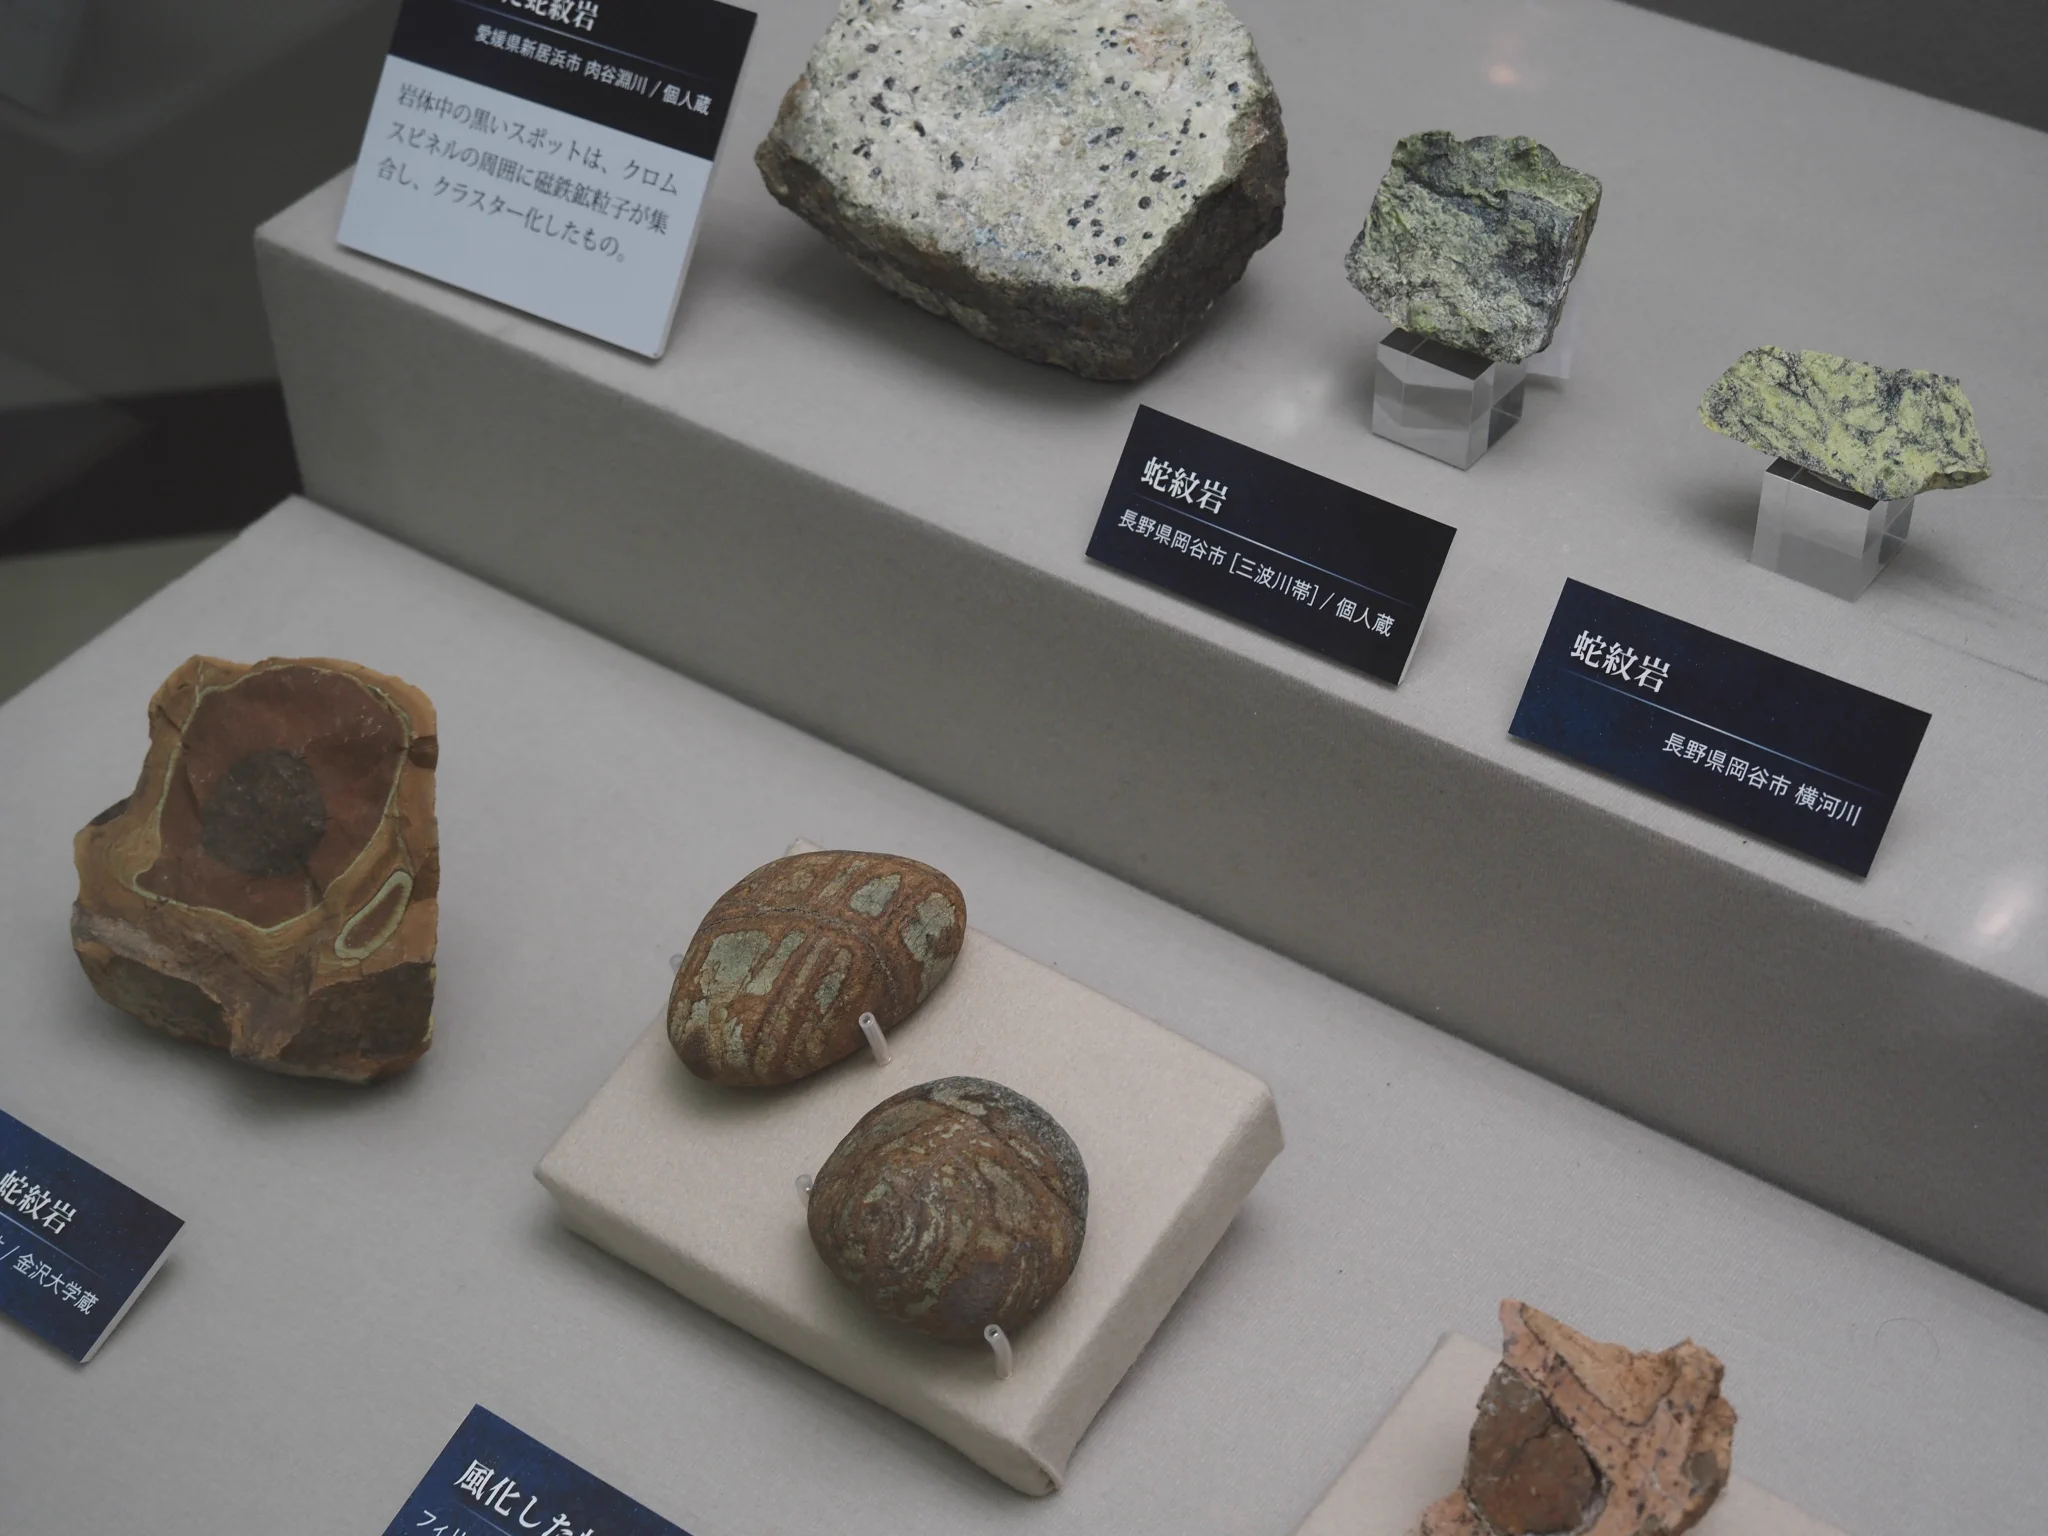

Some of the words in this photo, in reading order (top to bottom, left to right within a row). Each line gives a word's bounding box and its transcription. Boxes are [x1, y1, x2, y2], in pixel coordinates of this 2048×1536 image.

[475, 25, 583, 71] 愛媛県新居浜市
[649, 79, 663, 98] /
[662, 85, 712, 116] 個人蔵
[387, 121, 669, 235] スピネルの周囲に磁鉄鉱粒子が集
[397, 83, 678, 196] 岩体中の黒いスポットは、クロム
[377, 157, 624, 263] 合し、クラスター化したもの。
[1141, 456, 1229, 515] 蛇紋岩
[1118, 508, 1228, 566] 長野県岡谷市
[1228, 552, 1320, 607] [三波川帯]
[1319, 592, 1336, 610] /
[1335, 597, 1396, 638] 個人蔵
[1570, 629, 1671, 693] 蛇紋岩
[1662, 732, 1792, 796] 長野県岡谷市
[1794, 783, 1862, 827] 横河川
[12, 1253, 100, 1315] 金沢大学蔵
[453, 1458, 595, 1536] 風化した
